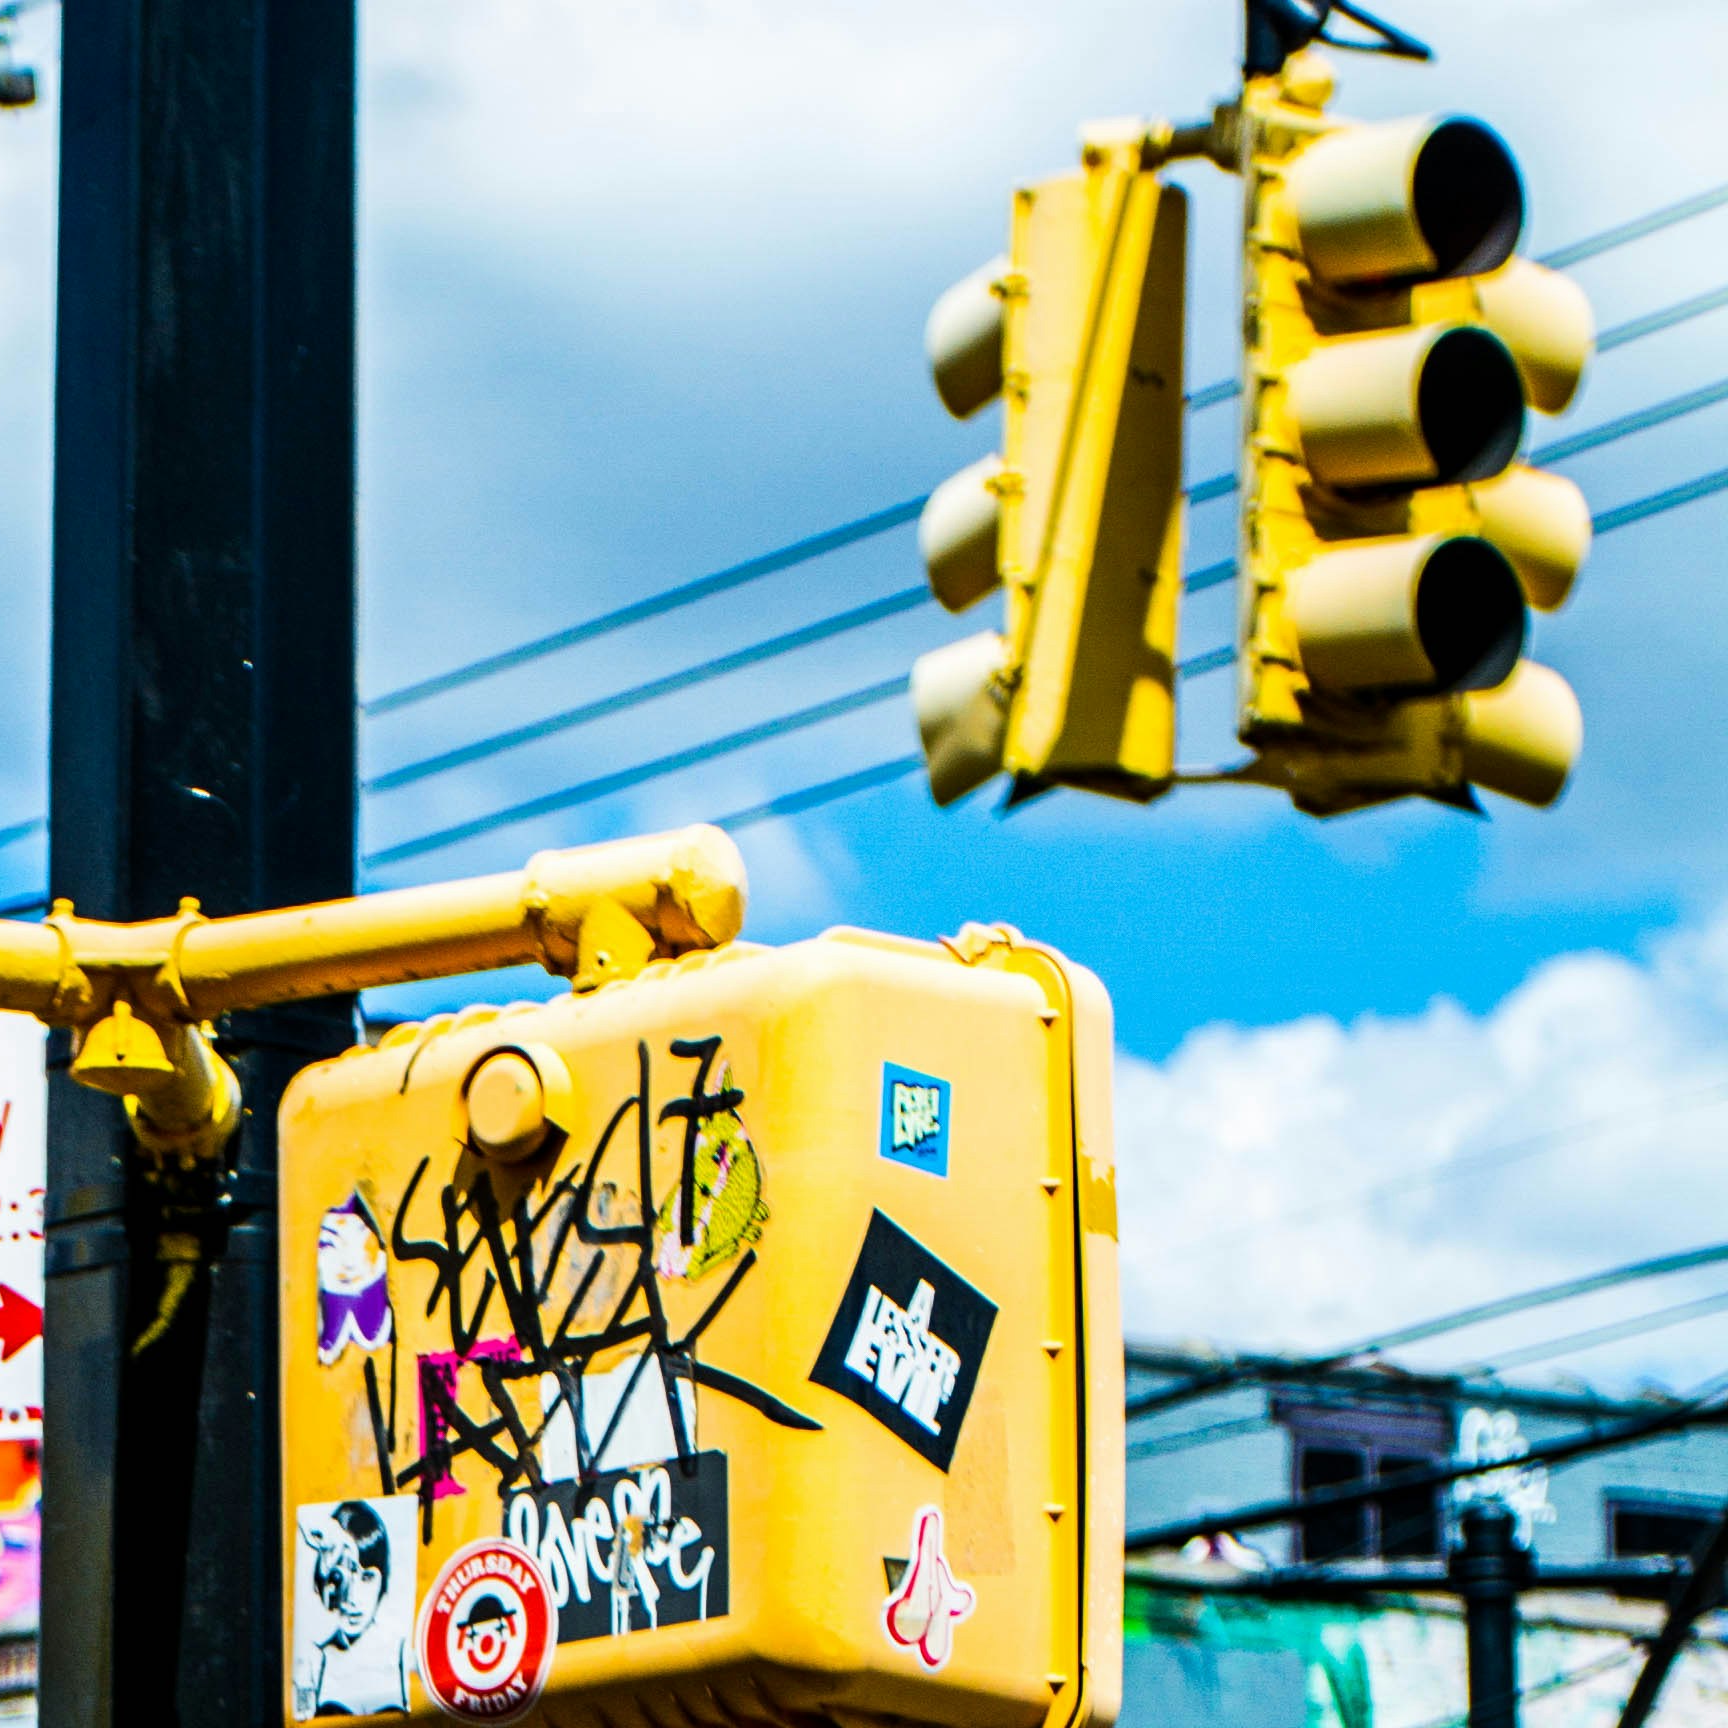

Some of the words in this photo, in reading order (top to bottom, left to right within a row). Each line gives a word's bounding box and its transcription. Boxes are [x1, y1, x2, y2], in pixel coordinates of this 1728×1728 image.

[844, 1345, 942, 1436] EVIL
[437, 1554, 537, 1615] THURSDAY
[455, 1669, 528, 1713] FRIDAY
